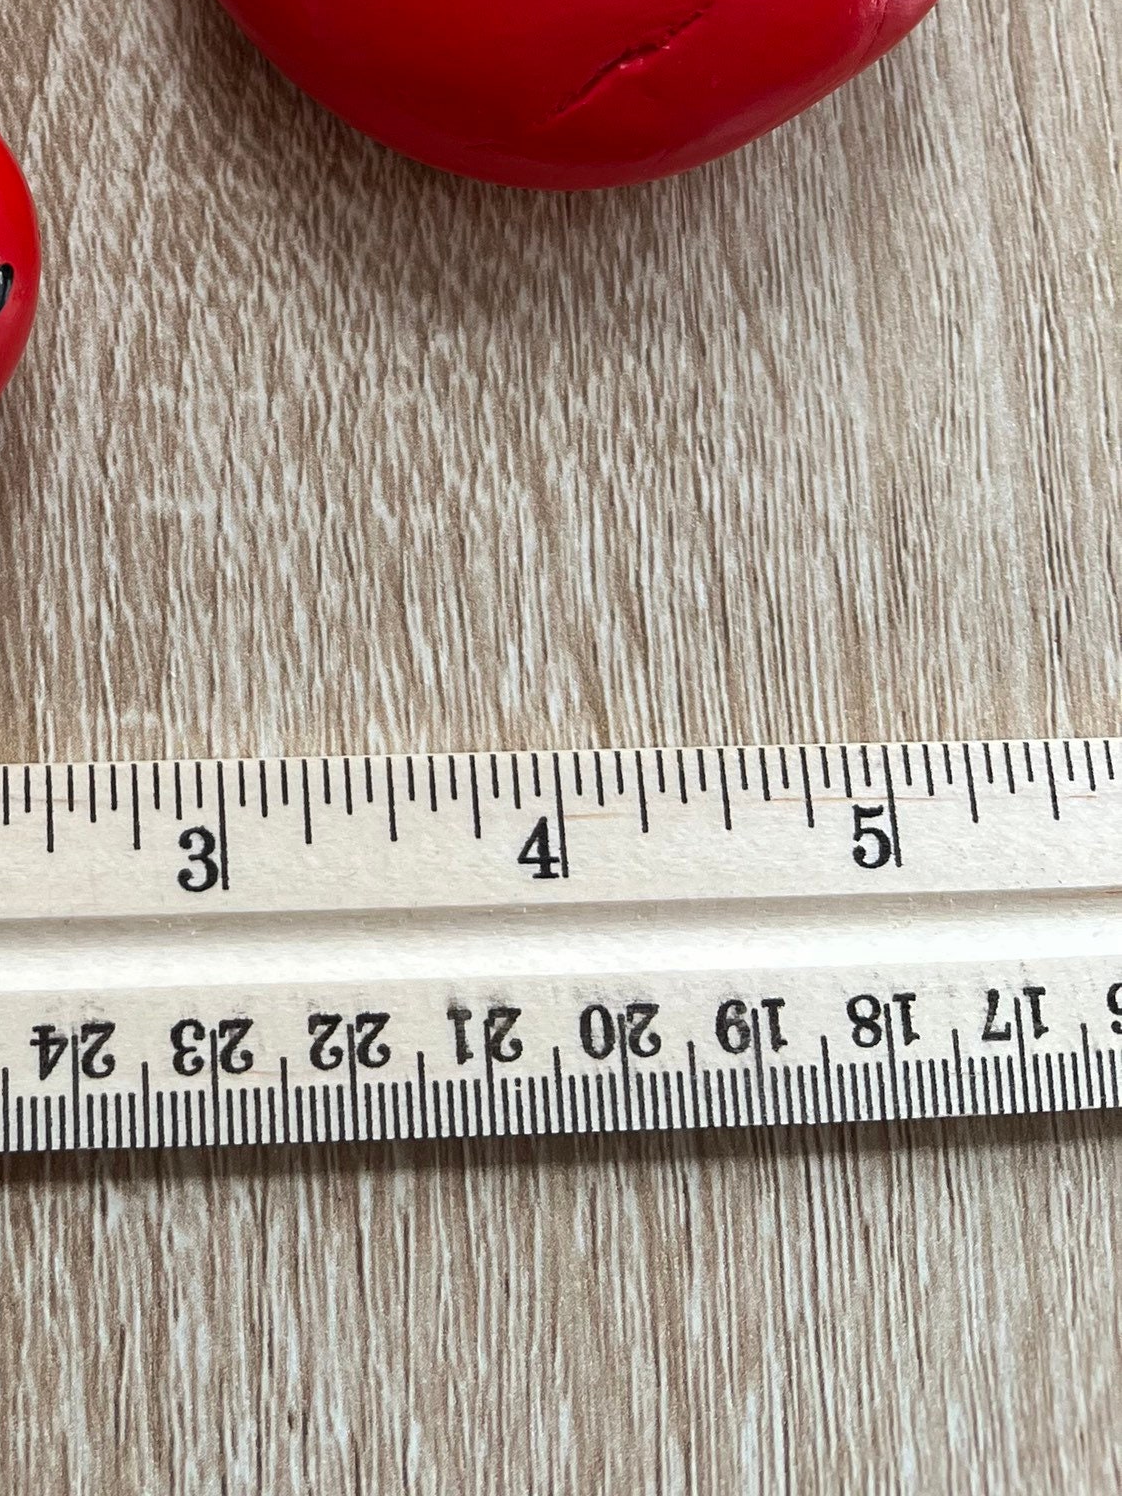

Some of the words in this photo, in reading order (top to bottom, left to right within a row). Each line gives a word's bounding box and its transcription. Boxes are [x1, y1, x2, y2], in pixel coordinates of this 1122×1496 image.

[178, 826, 218, 892] 3
[518, 817, 559, 879] 4
[853, 805, 891, 868] 5
[308, 1012, 390, 1070] 22
[447, 1006, 523, 1064] 21
[580, 1004, 661, 1058] 20
[716, 999, 787, 1053] 19
[847, 993, 920, 1045] 18
[982, 987, 1048, 1038] 17
[30, 1022, 115, 1082] 24
[171, 1019, 253, 1076] 23
